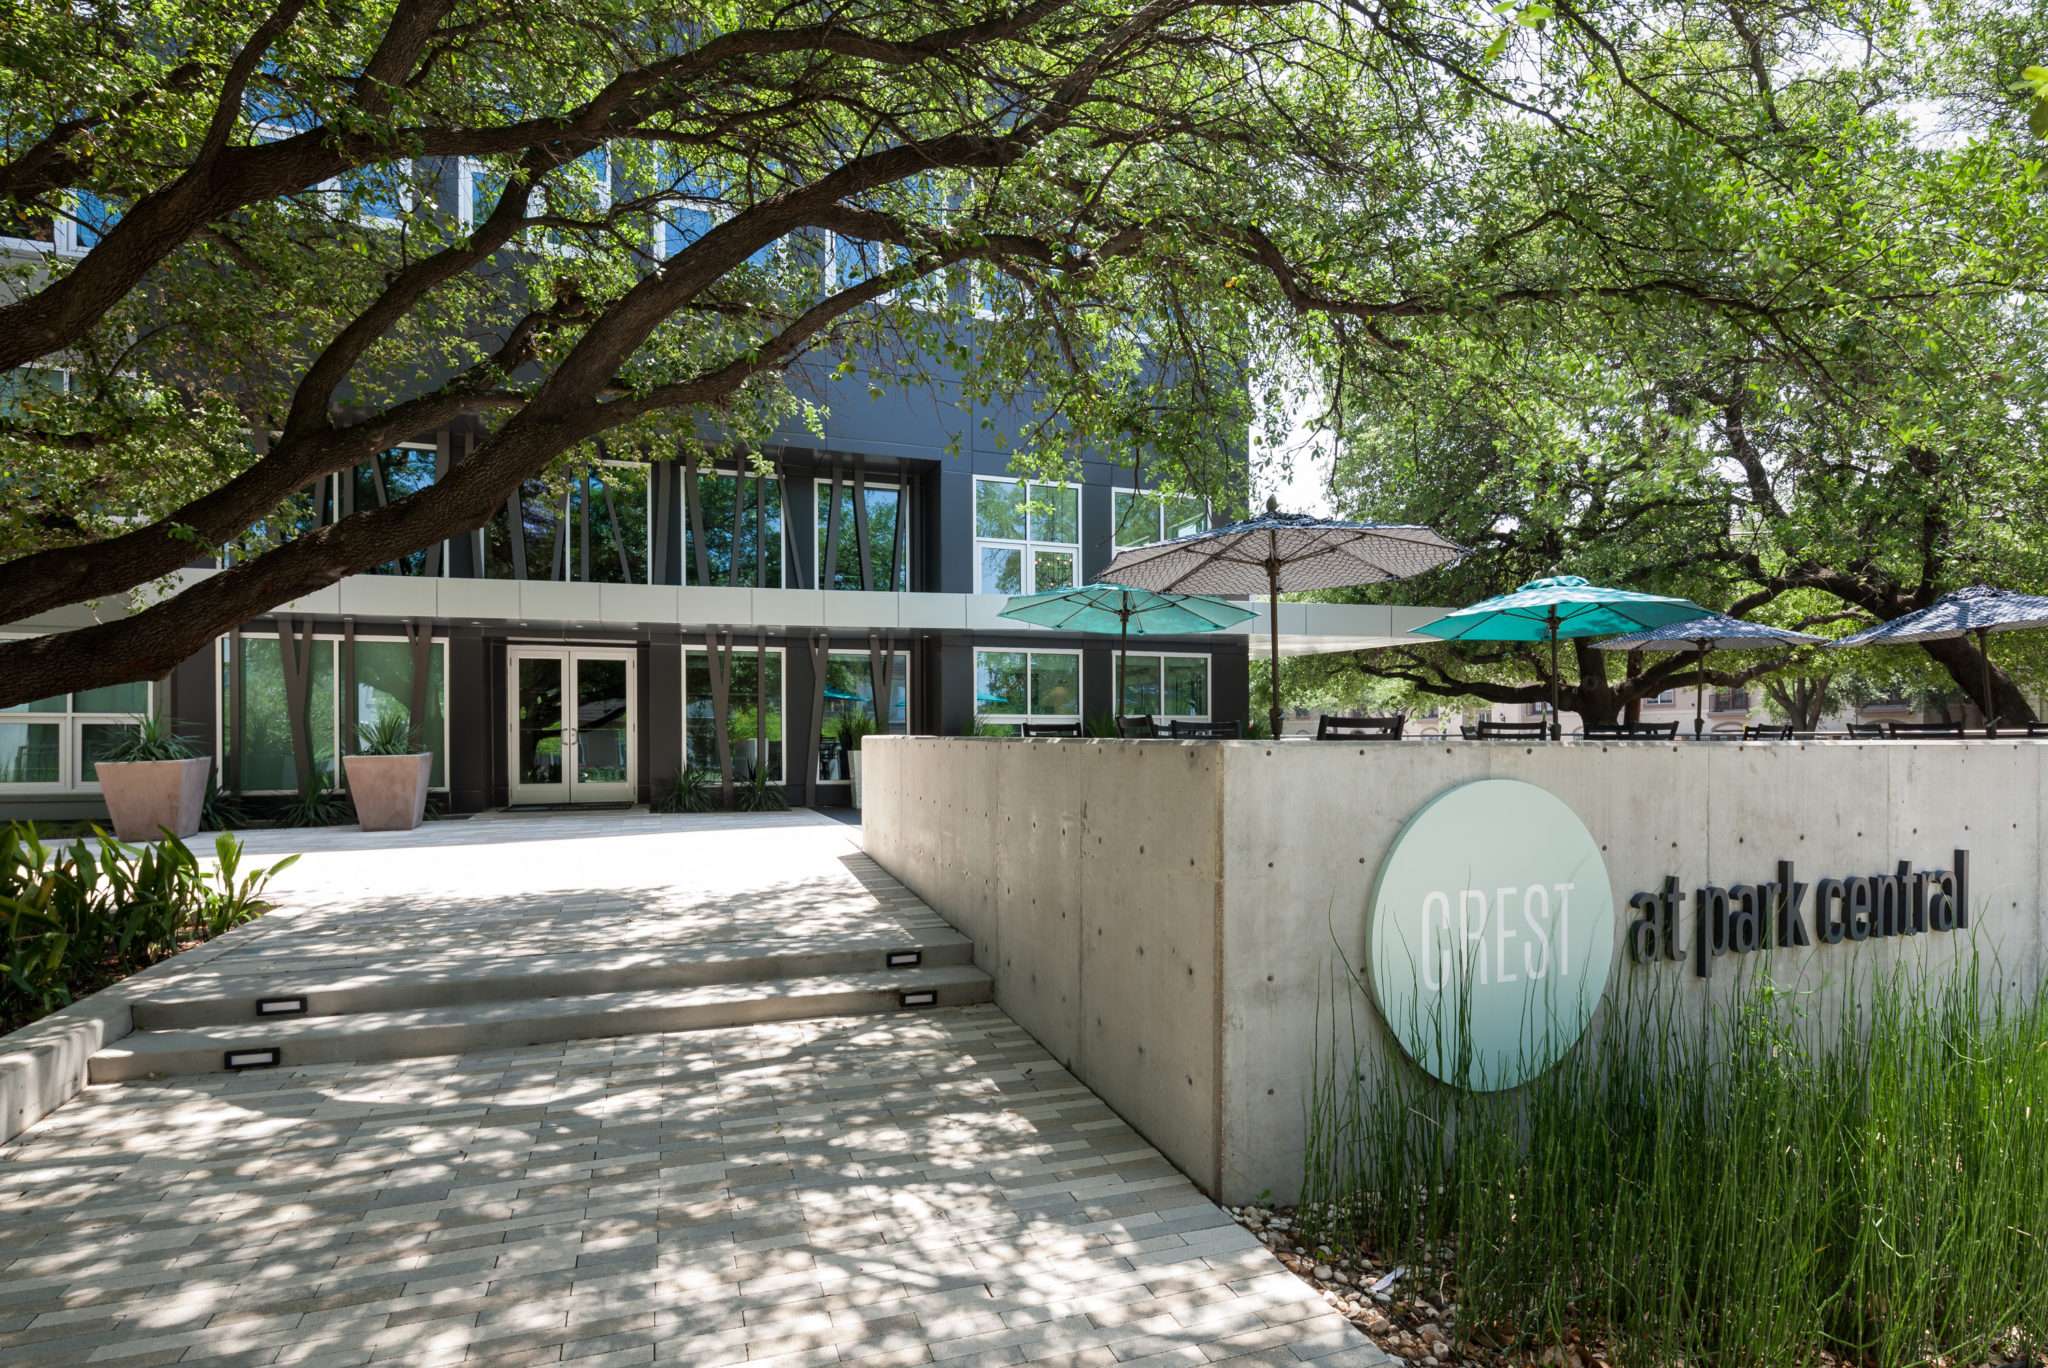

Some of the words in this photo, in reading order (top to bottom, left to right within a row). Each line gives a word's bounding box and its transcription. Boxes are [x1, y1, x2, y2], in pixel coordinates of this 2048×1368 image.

[1422, 883, 1576, 992] CREST
[1629, 875, 1687, 965] at
[1696, 860, 1810, 978] park
[1816, 849, 1969, 944] central
